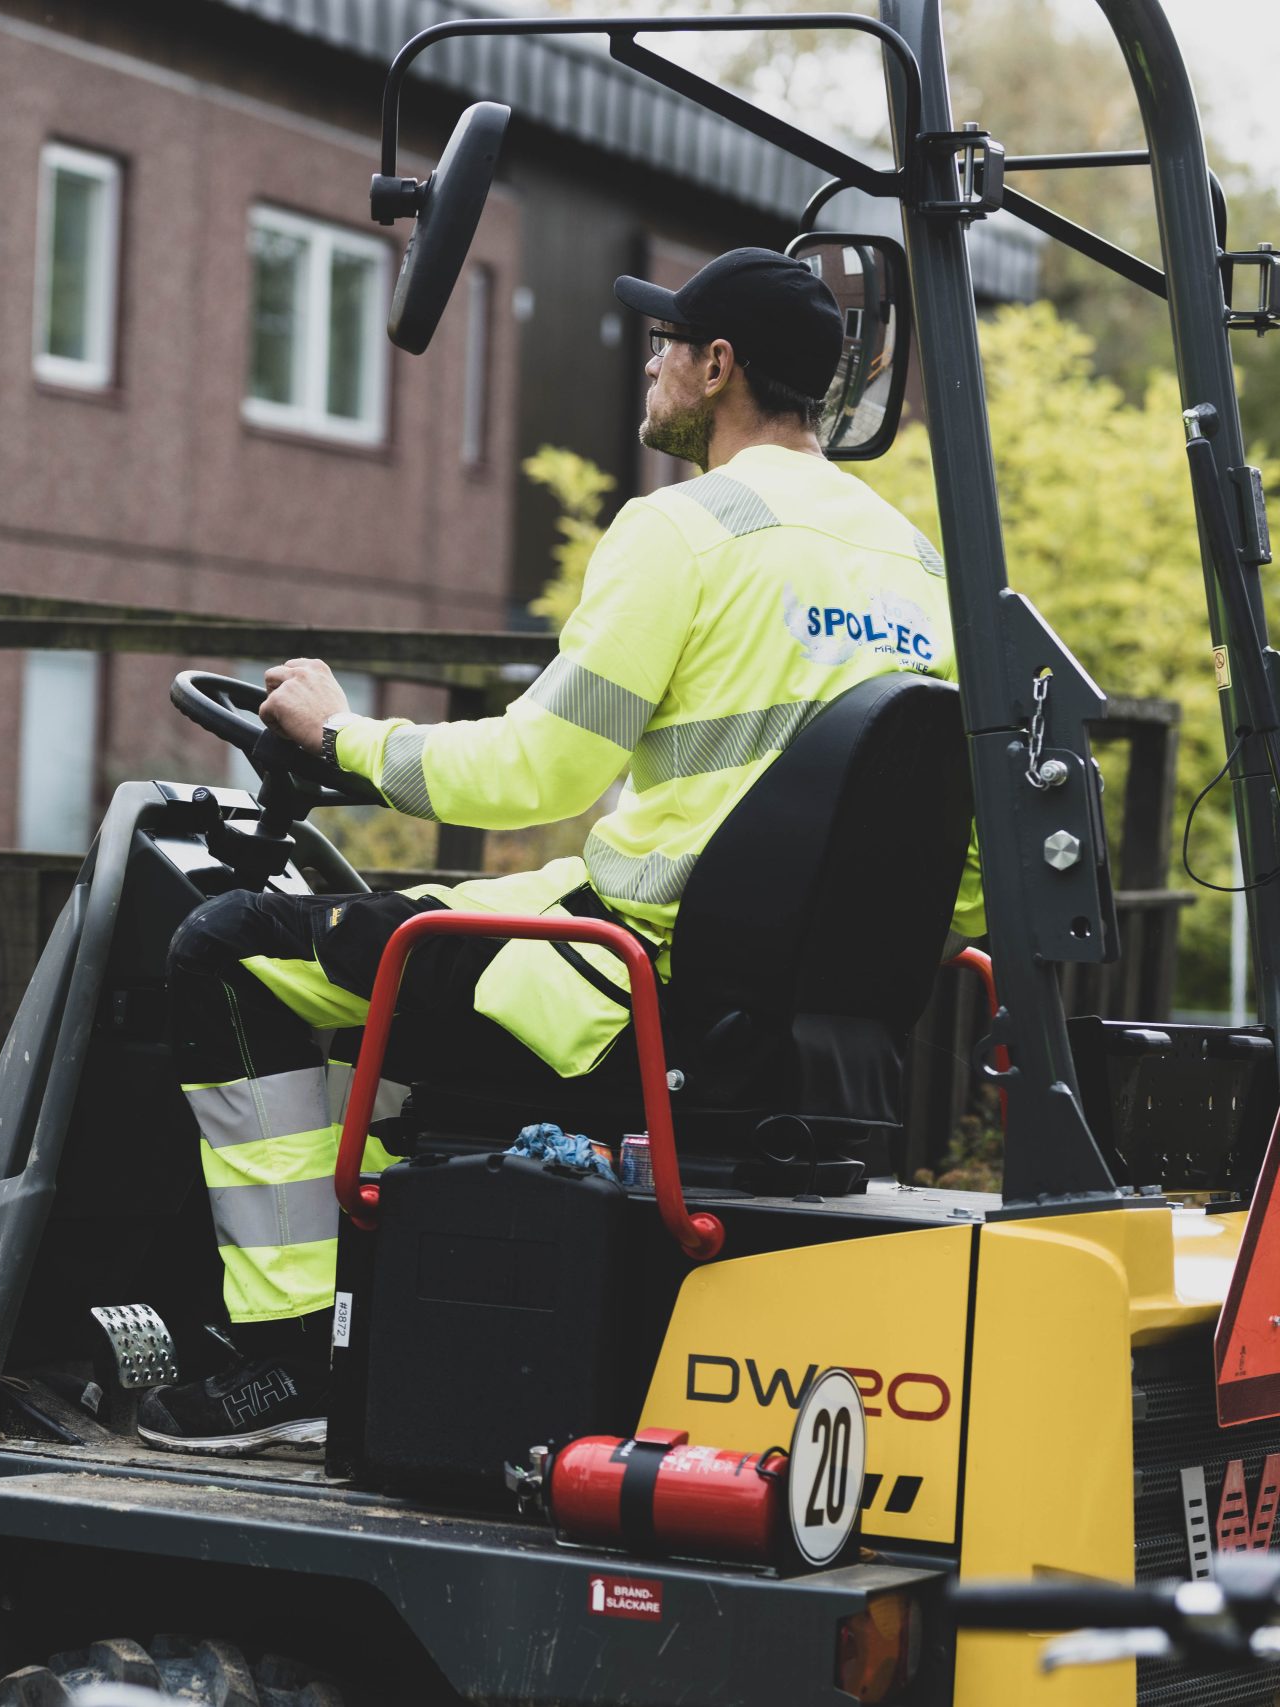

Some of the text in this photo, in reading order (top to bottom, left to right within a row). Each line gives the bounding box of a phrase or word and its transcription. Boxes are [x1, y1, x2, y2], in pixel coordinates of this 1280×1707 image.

[807, 605, 933, 661] SPOLEC
[336, 1301, 349, 1337] #3872
[222, 1370, 289, 1427] HH
[686, 1354, 951, 1422] DW20
[804, 1406, 852, 1528] 20
[606, 1596, 661, 1613] SLÄCKARE
